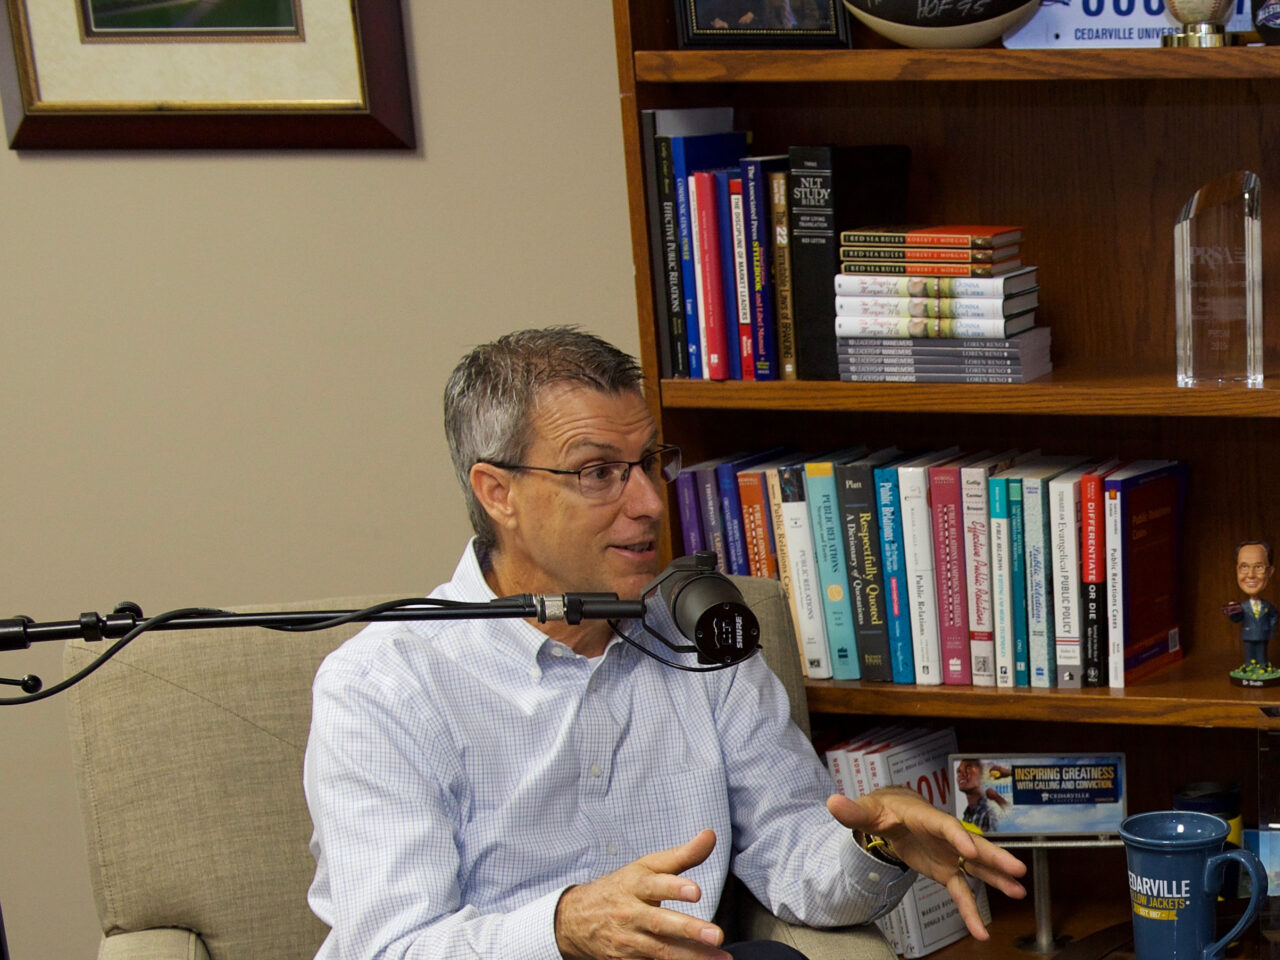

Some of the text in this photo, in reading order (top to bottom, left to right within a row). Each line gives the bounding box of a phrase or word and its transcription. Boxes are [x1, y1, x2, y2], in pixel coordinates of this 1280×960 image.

[1074, 27, 1135, 41] CEDARVILLE
[747, 166, 755, 178] The
[800, 177, 823, 188] NLT
[748, 180, 758, 219] Associated
[793, 187, 831, 199] STUDY
[801, 198, 825, 206] BIBLE
[663, 202, 675, 240] EFFECTIVE
[751, 221, 759, 239] Press
[776, 211, 786, 225] The
[776, 227, 788, 244] 22
[666, 243, 677, 270] PUBLIC
[735, 212, 749, 320] DISCIPLINE OF MARKET LEADERS
[752, 241, 762, 291] STYLEBOOK
[669, 272, 680, 313] RELATIONS
[780, 289, 790, 311] Laws
[782, 322, 793, 359] BRANDING
[845, 480, 863, 490] Platt
[880, 482, 895, 541] Public Relations
[774, 503, 789, 573] Public Relations
[822, 494, 842, 575] PUBLIC RELATIONS
[948, 504, 961, 591] PUBLIC RELATIONS CAMPAIGN
[968, 521, 987, 557] Effective
[846, 513, 865, 625] A Dictionary Quotations
[858, 512, 884, 625] Respectfully Quoted
[974, 560, 989, 586] Public
[1056, 522, 1073, 634] Evangelical PUBLIC POLICY
[1087, 502, 1097, 620] DIFFERENTIATE OR DIE
[1111, 548, 1119, 574] Public
[800, 550, 816, 620] PUBLIC RELATIONS
[941, 562, 950, 627] IMPLEMENTATION
[1033, 546, 1044, 624] Public Relations
[1111, 578, 1119, 606] Relations
[915, 574, 927, 636] Public Relations
[975, 588, 992, 626] Relations
[735, 615, 744, 650] SHURE
[1014, 766, 1115, 780] INSPIRING GREATNESS
[1016, 780, 1114, 791] WITH CALLING AND CONVICTION.
[1050, 792, 1090, 800] CEDARVILLE
[1128, 870, 1191, 898] EDARVILLE
[1148, 896, 1186, 909] JACKETS
